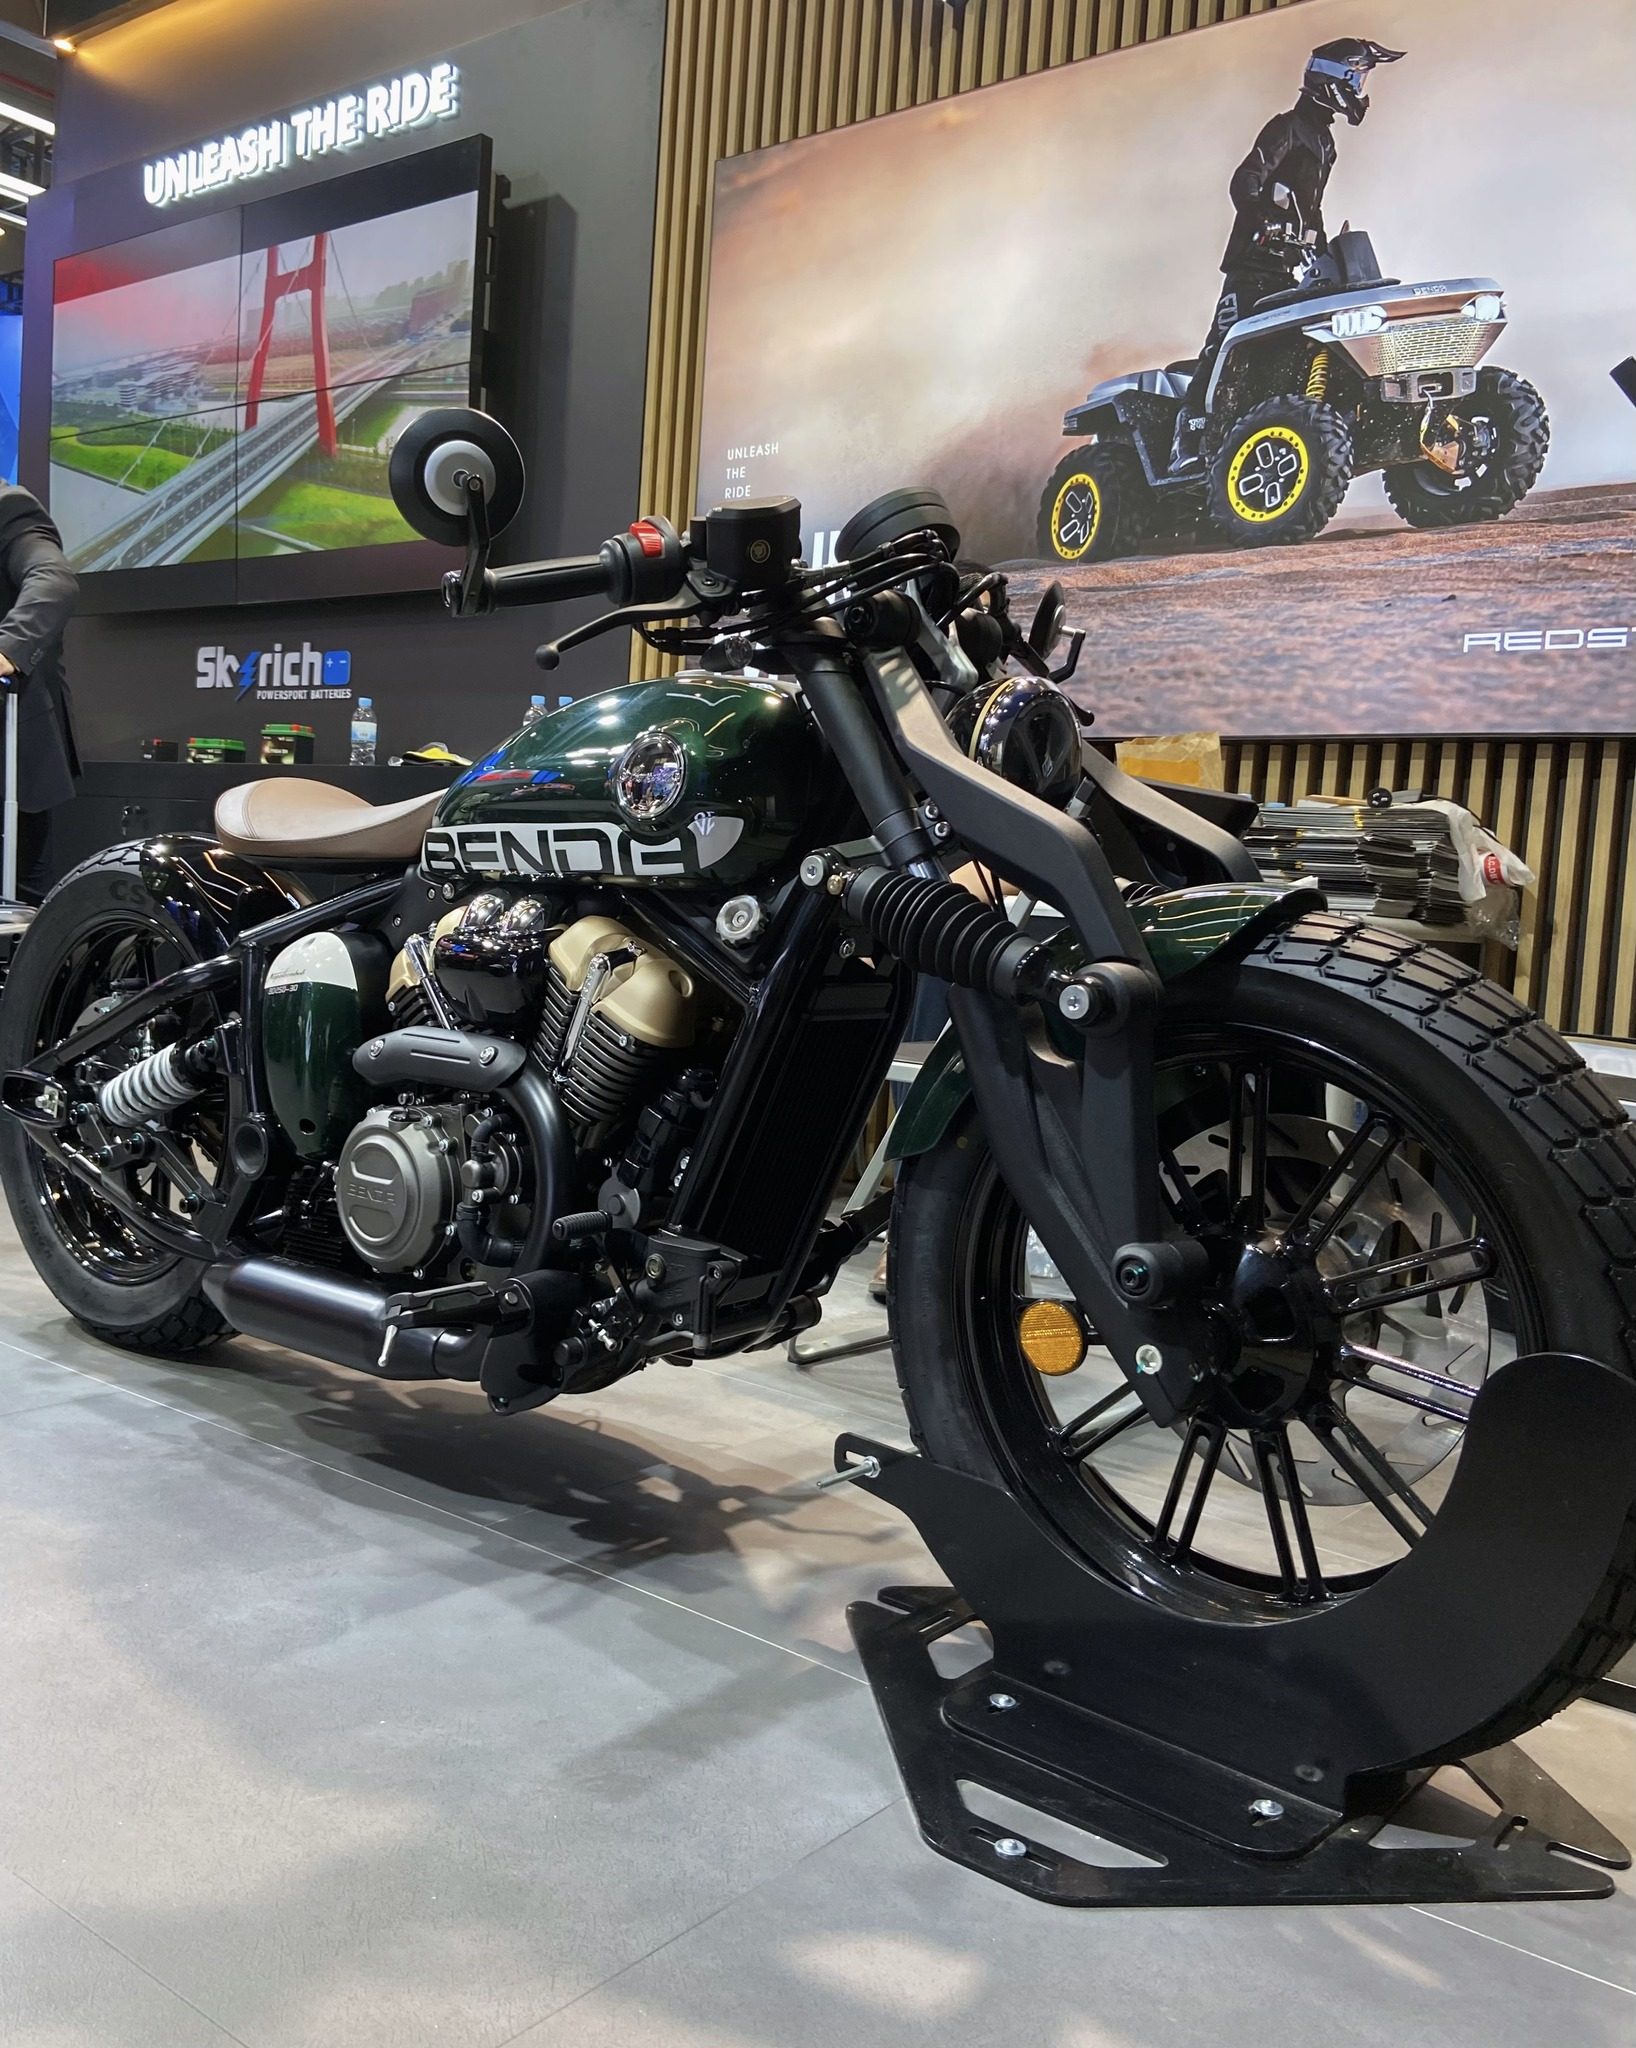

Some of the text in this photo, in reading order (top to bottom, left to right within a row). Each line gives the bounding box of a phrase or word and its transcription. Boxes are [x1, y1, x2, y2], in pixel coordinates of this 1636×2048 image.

[144, 62, 460, 206] UNLEASH THE RIDE
[727, 442, 779, 460] UNLEASH
[726, 466, 746, 479] THE
[724, 485, 751, 499] RIDE
[1463, 627, 1636, 653] REDS
[256, 688, 352, 700] POWERSPORT BATTERIES
[347, 1183, 397, 1207] BENDA
